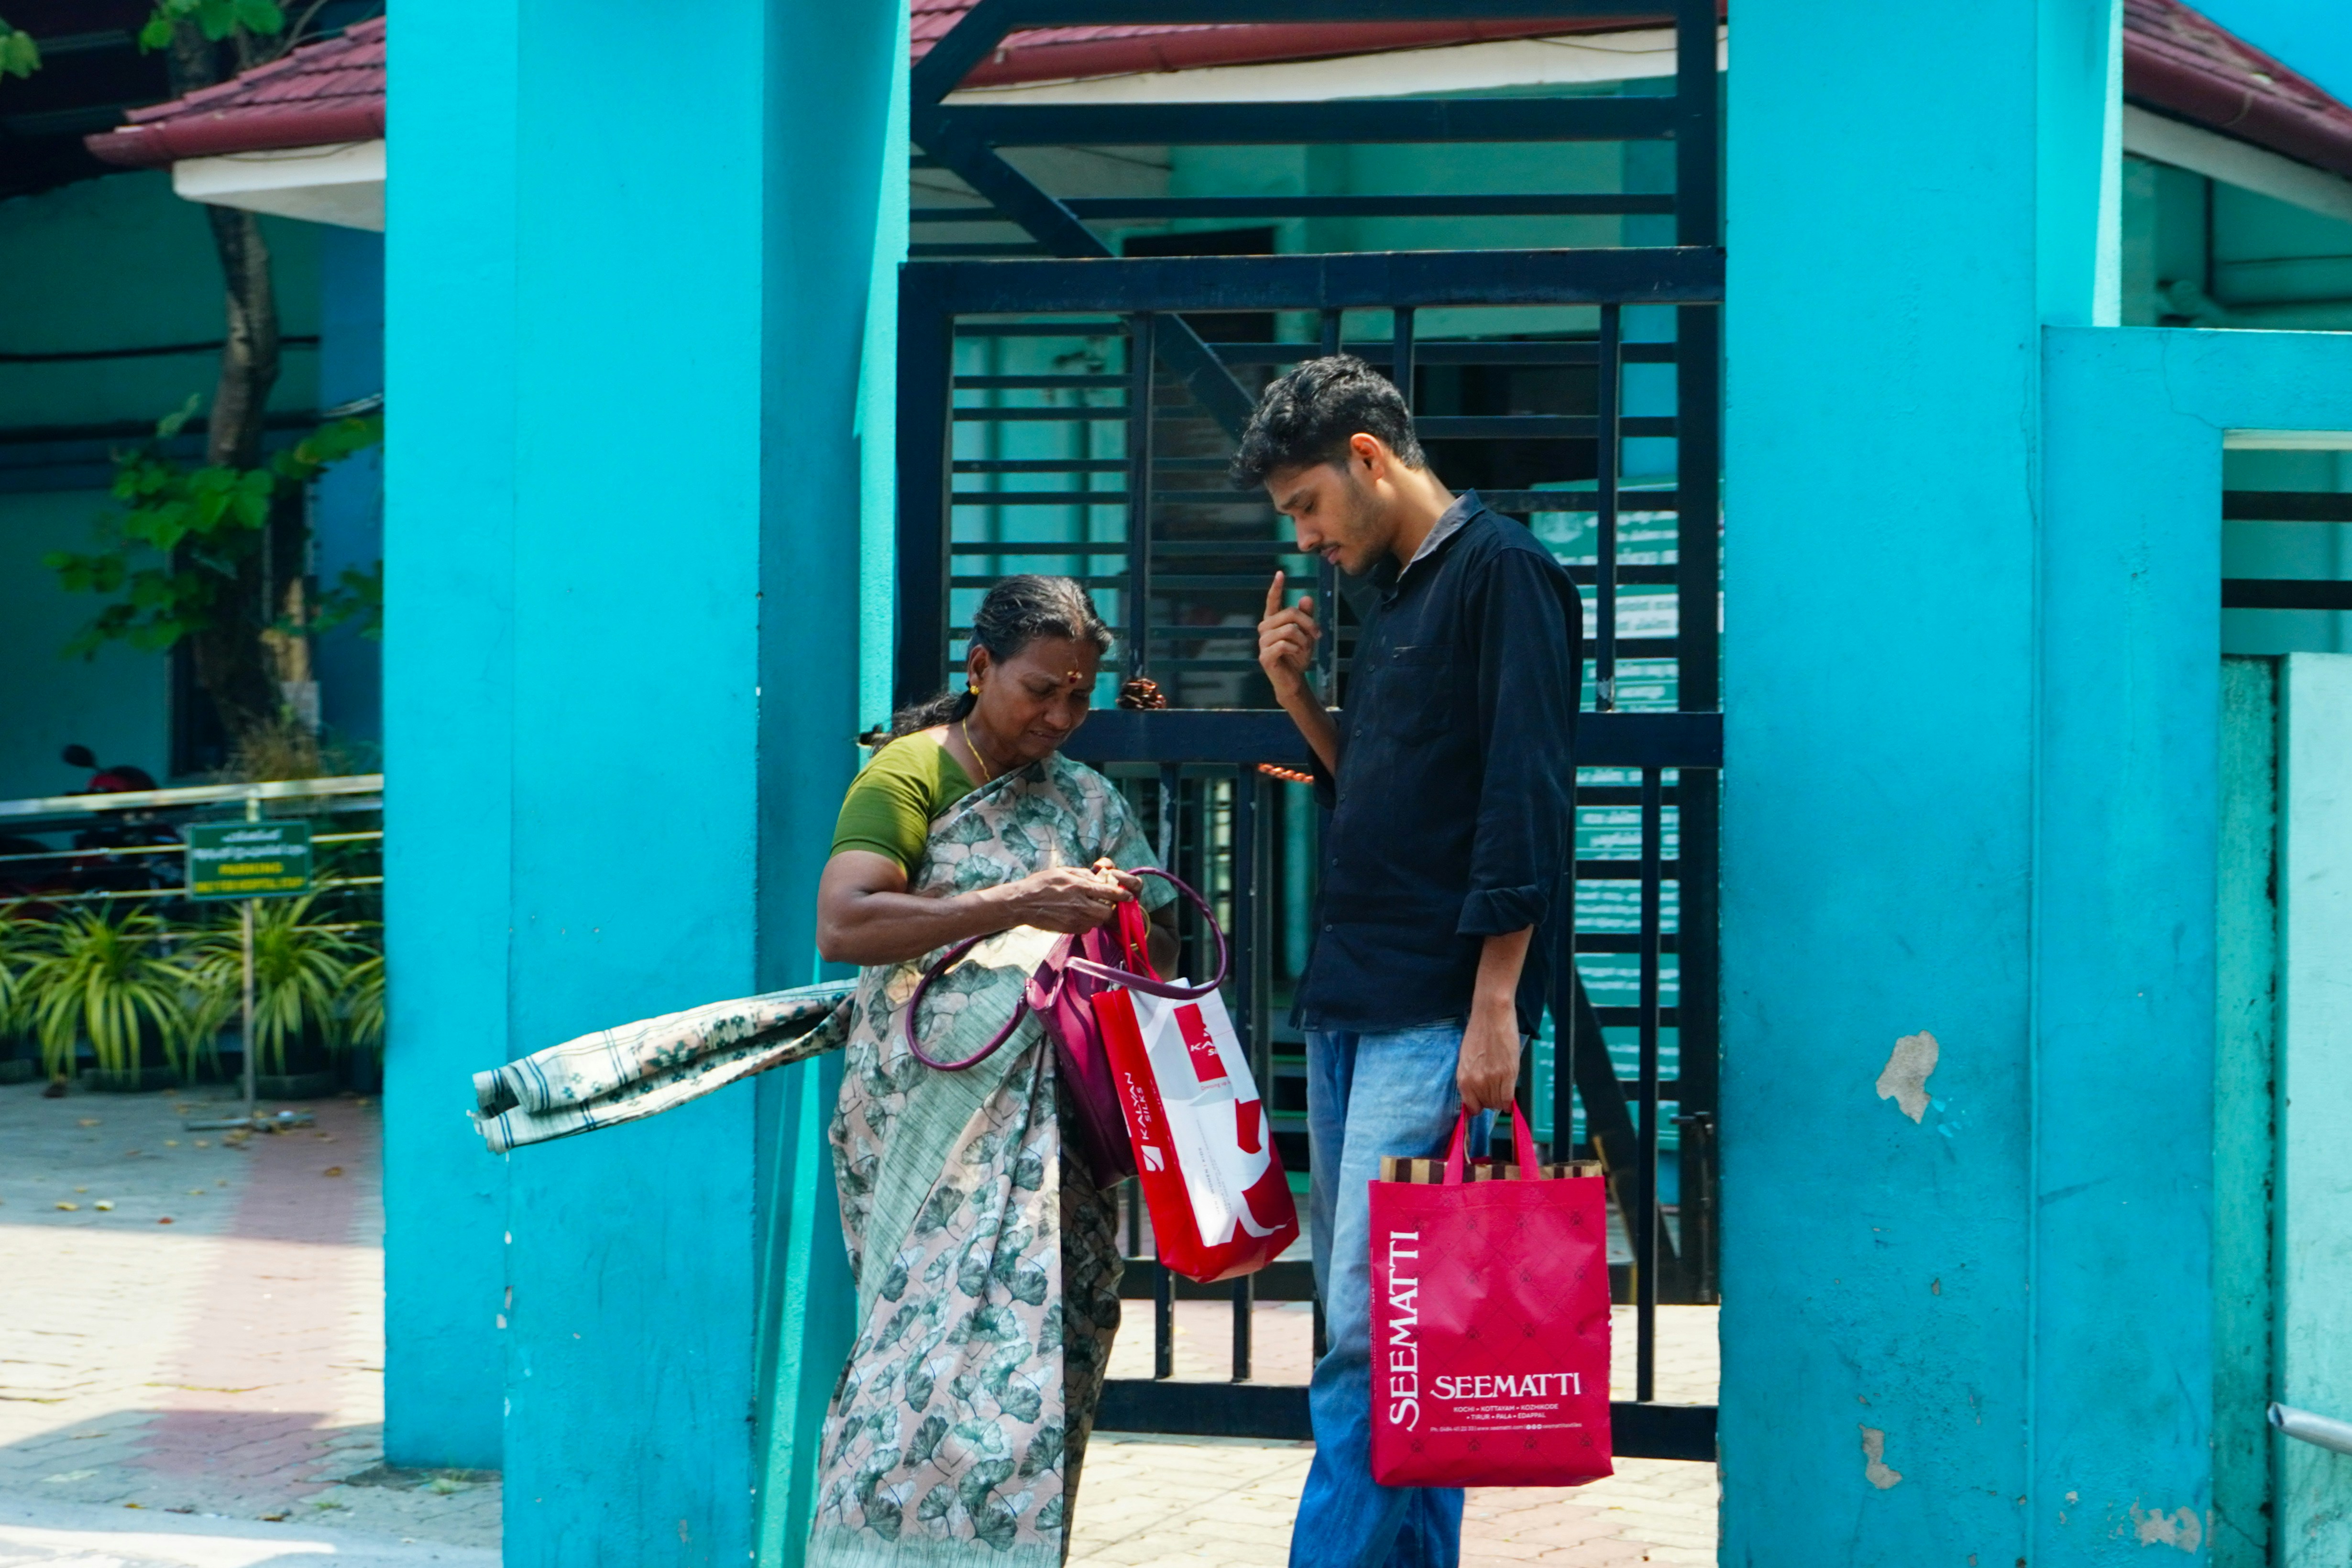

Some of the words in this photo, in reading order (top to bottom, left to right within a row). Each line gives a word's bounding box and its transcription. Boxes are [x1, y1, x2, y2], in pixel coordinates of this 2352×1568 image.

[1124, 1072, 1149, 1140] KALYAN
[1136, 1087, 1152, 1122] SILKS
[1204, 1169, 1215, 1194] WOMEN
[1389, 1230, 1419, 1432] SEEMATTI
[1429, 1372, 1581, 1400] SEEMATTI
